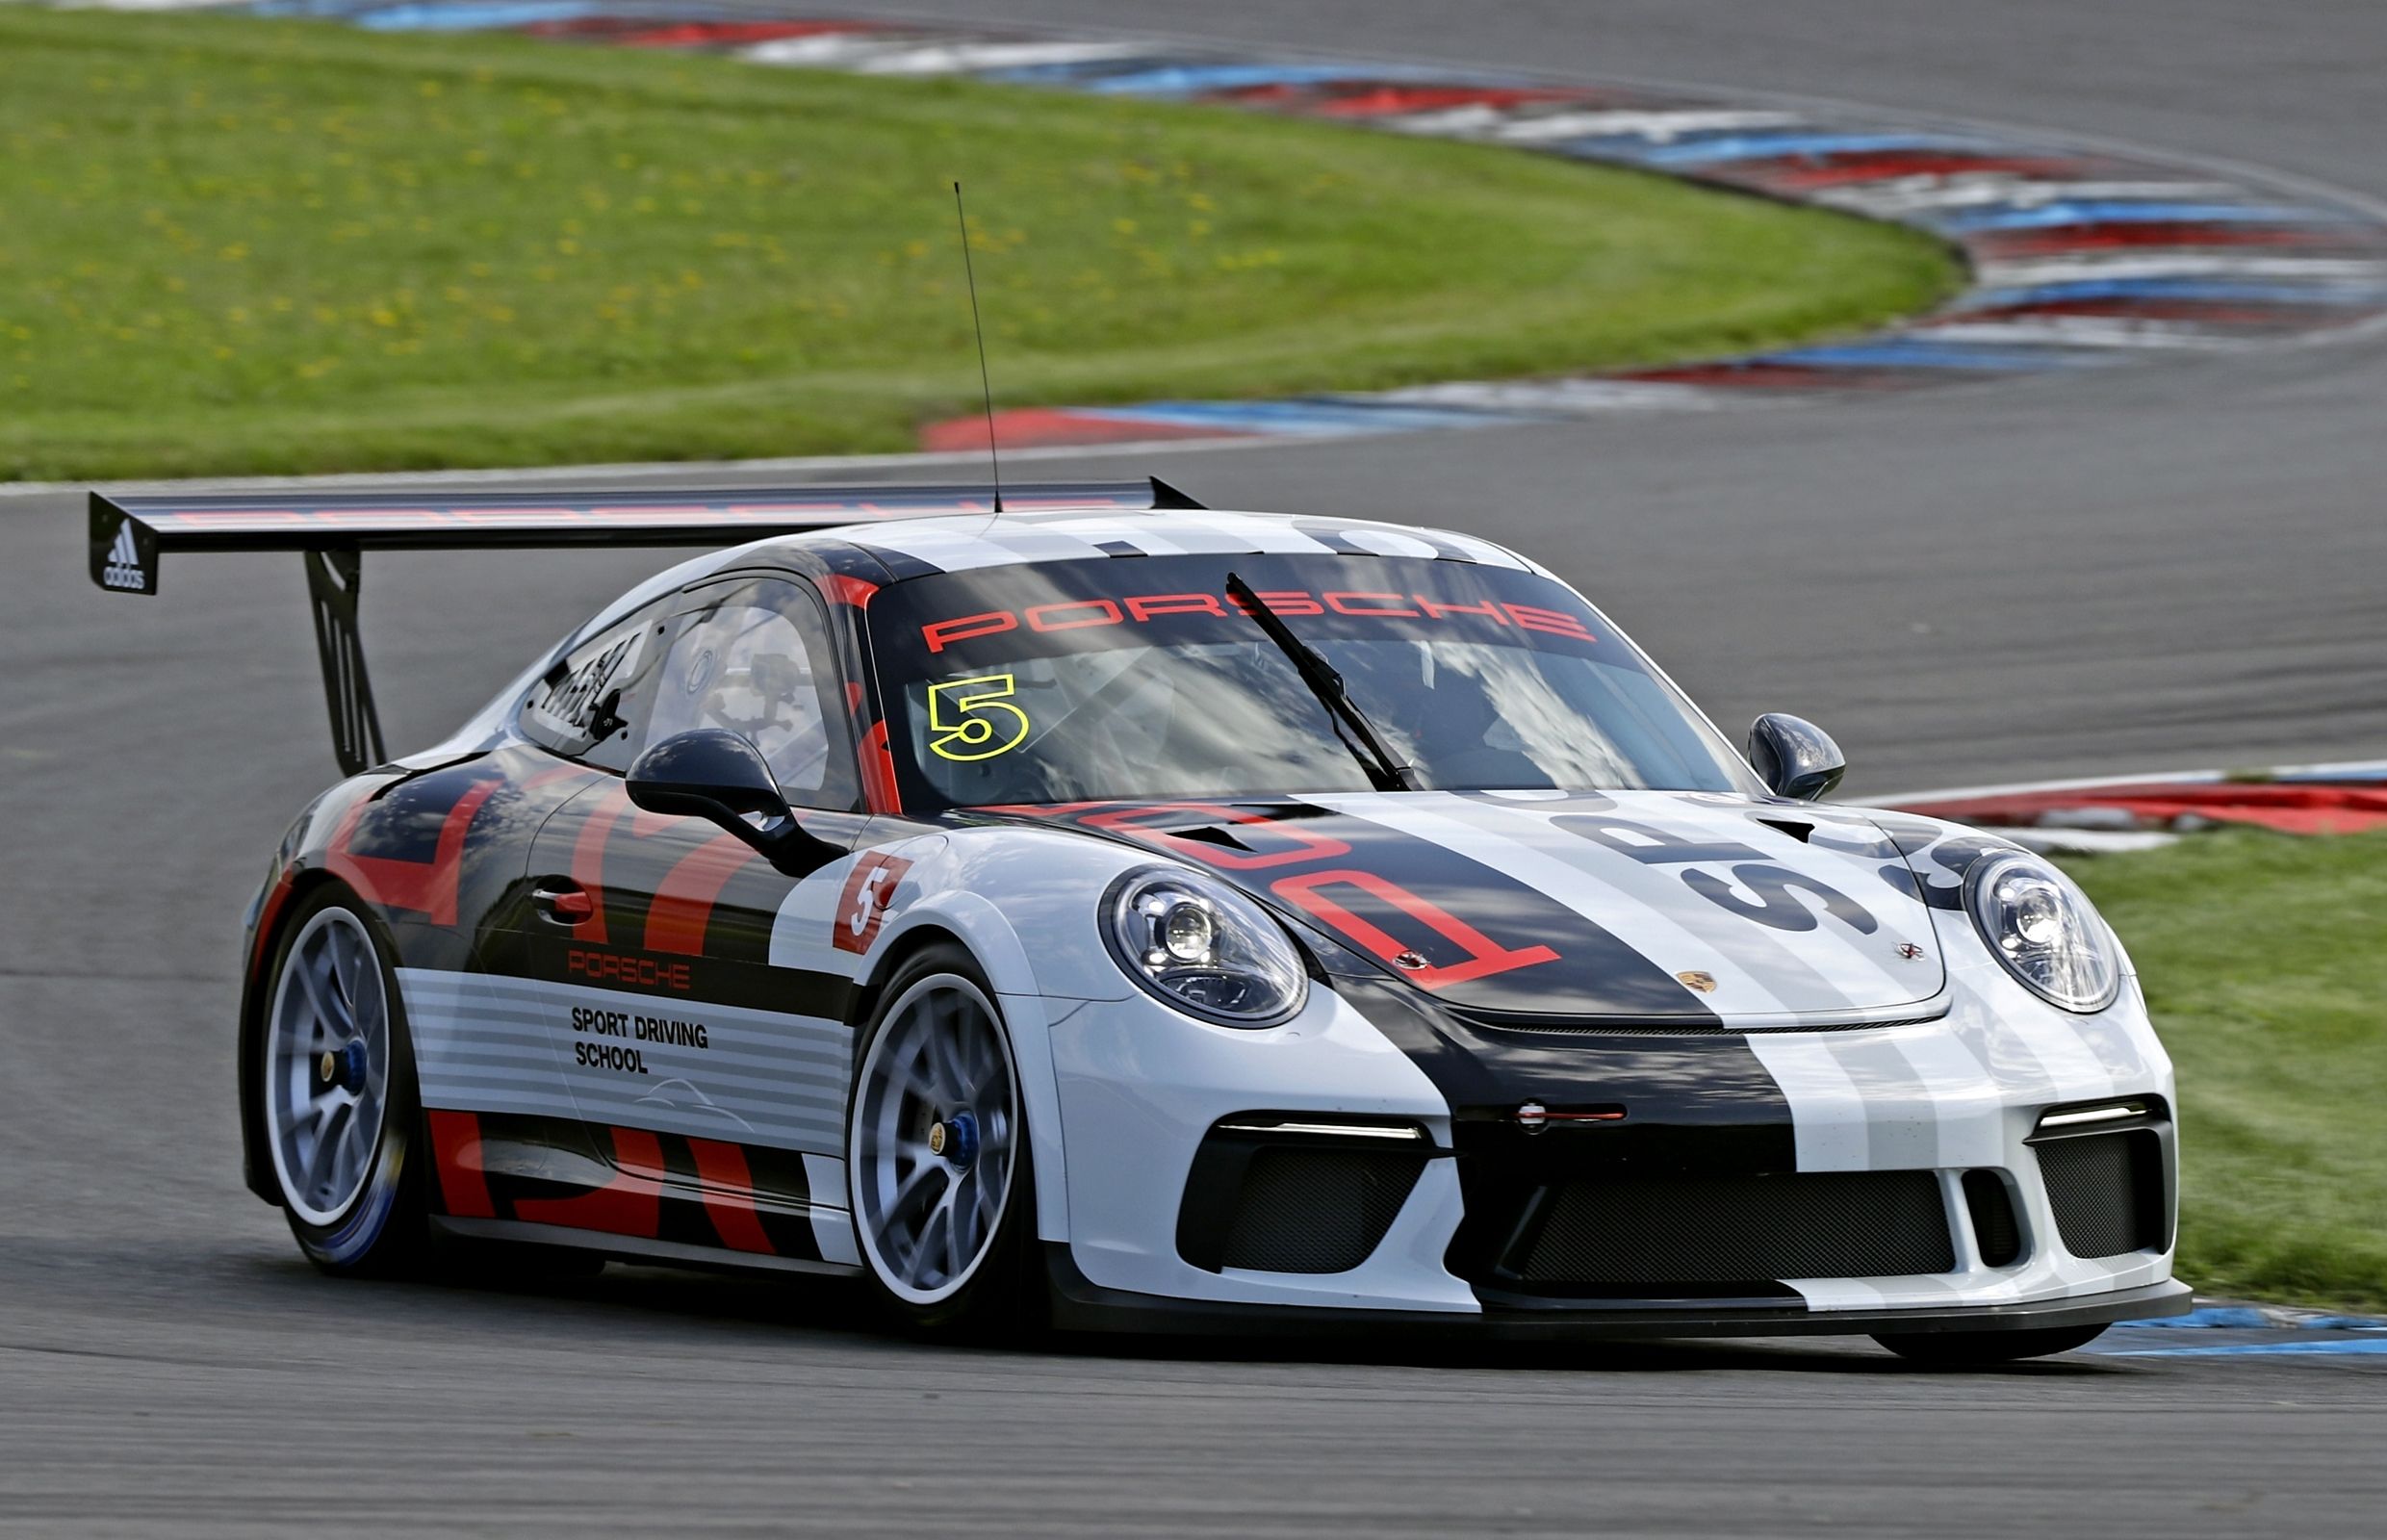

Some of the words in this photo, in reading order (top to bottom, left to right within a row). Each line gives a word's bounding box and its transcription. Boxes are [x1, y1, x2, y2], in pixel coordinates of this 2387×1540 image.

[103, 564, 145, 589] adidas
[921, 591, 1598, 654] PORSCHE
[928, 674, 1030, 761] 5
[851, 866, 890, 937] 5
[568, 949, 691, 990] PORSCHE
[572, 1007, 629, 1038] SPORT
[634, 1015, 709, 1049] DRIVING
[575, 1041, 649, 1074] SCHOOL
